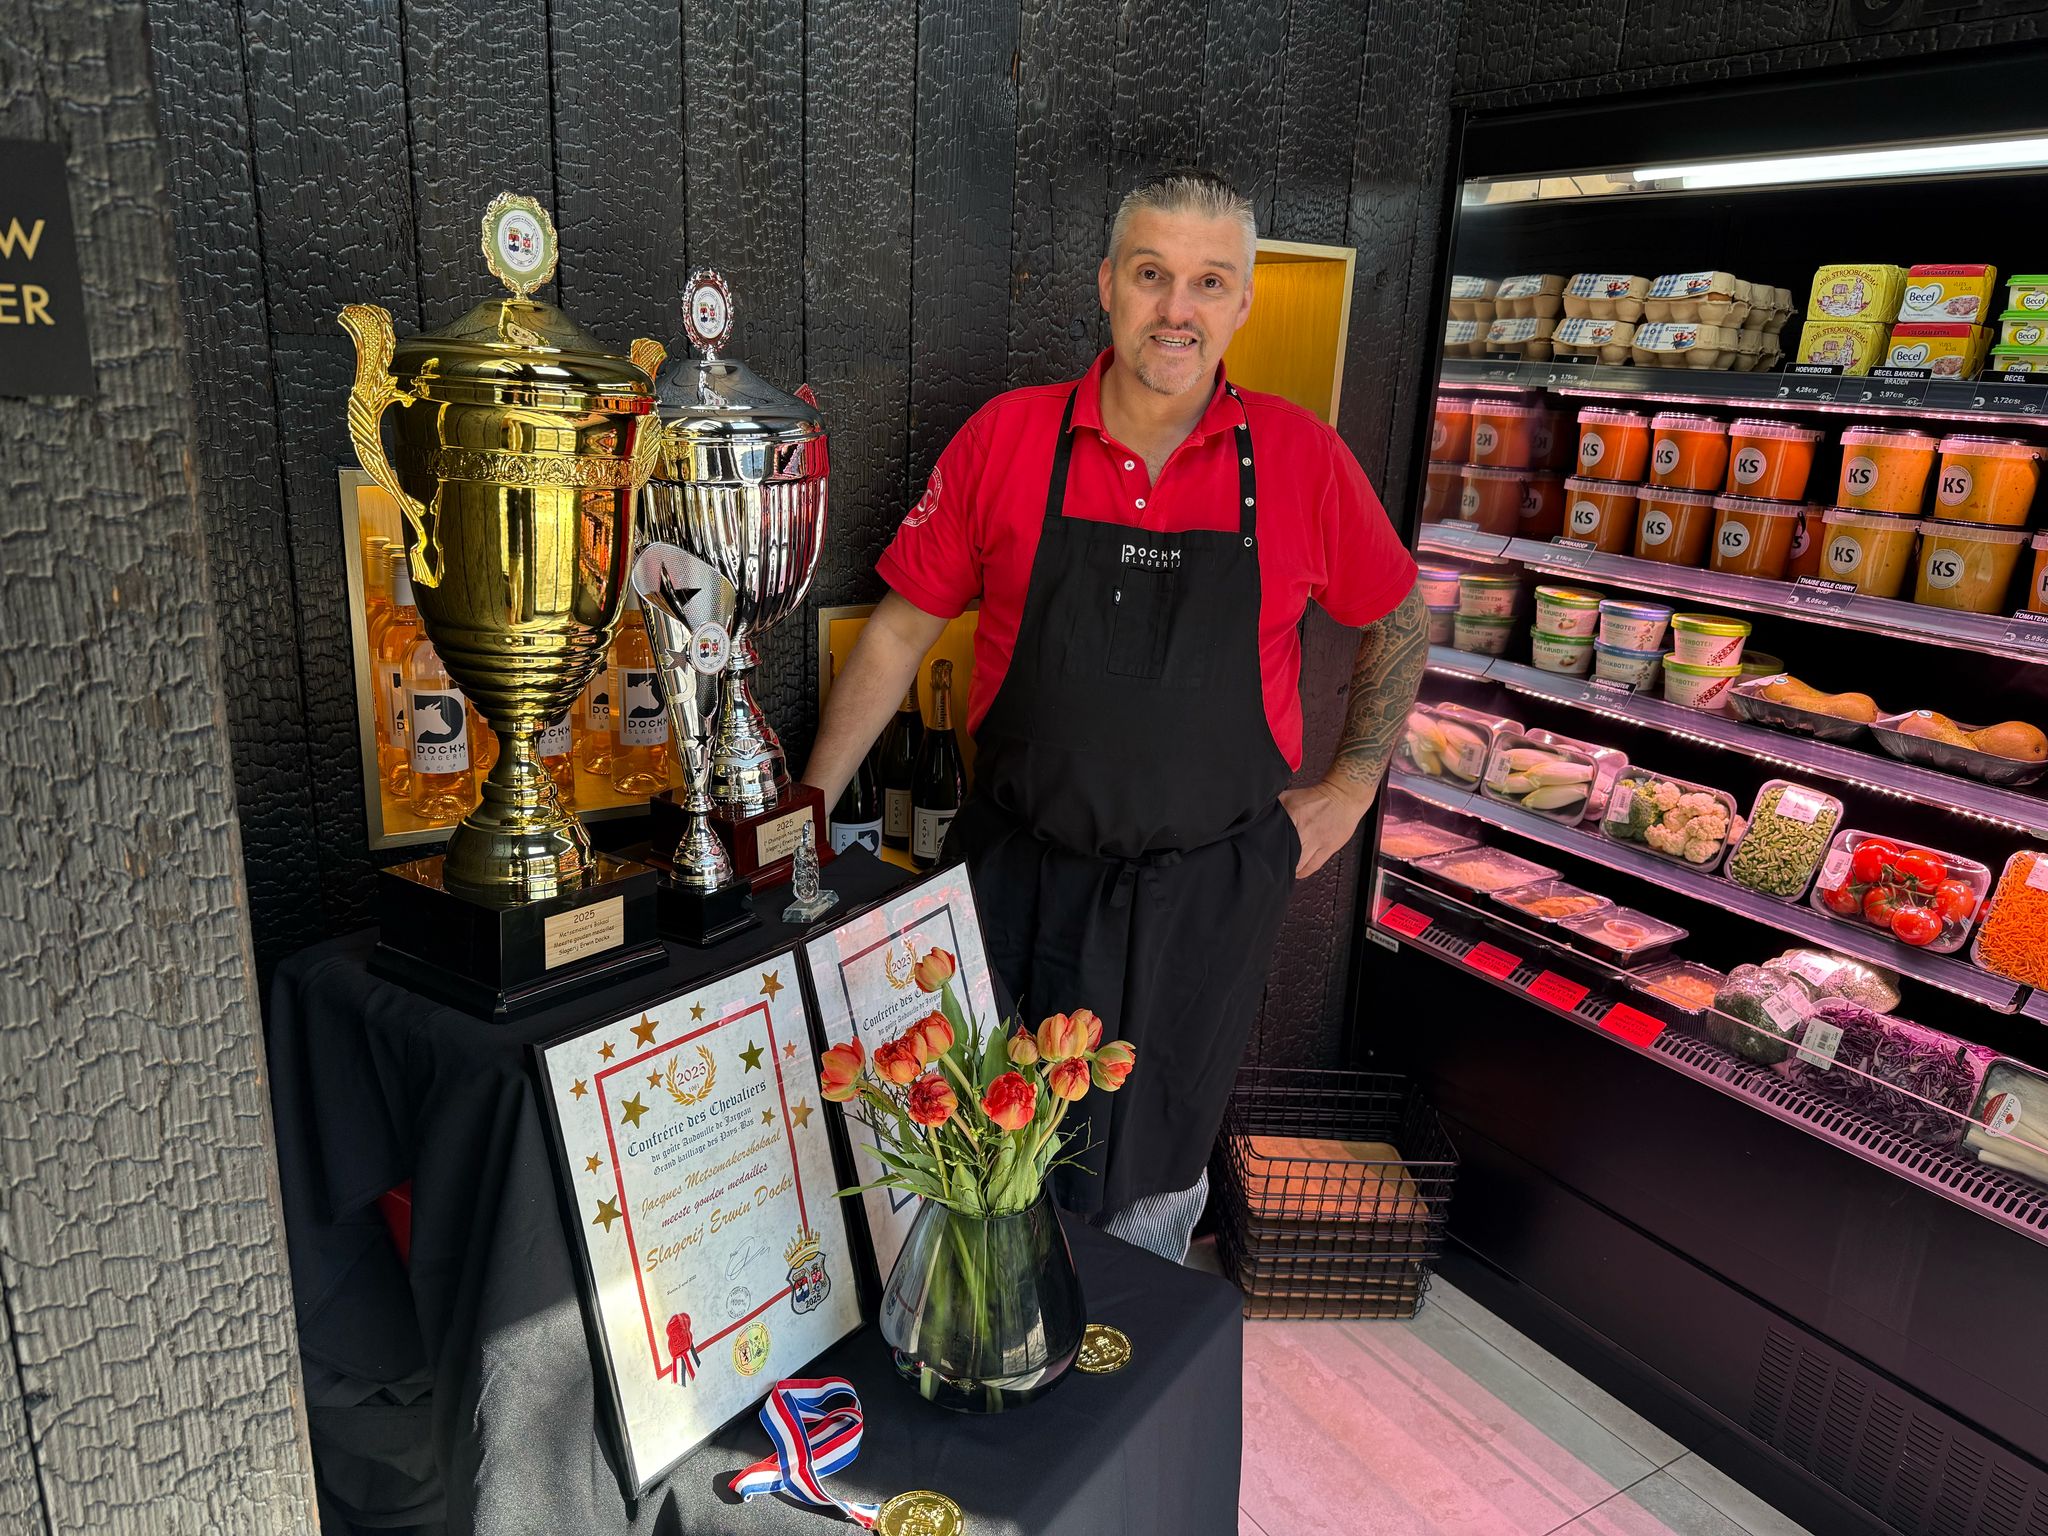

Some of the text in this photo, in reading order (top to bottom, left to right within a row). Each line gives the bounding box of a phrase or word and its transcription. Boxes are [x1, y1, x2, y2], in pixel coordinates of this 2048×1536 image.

[1909, 291, 1935, 302] Becel
[2025, 297, 2045, 305] Becel
[2018, 332, 2037, 340] Becel
[1896, 351, 1922, 361] Becel
[1795, 366, 1833, 374] HOEVEBOTER
[1873, 369, 1893, 377] BECEL
[1893, 370, 1919, 378] BAKKEN
[1884, 378, 1909, 386] BRADEN
[2003, 375, 2026, 383] BECEL
[1582, 442, 1599, 457] KS
[1655, 450, 1674, 464] KS
[1738, 458, 1760, 474] KS
[1848, 468, 1871, 484] KS
[1942, 477, 1967, 494] KS
[1573, 510, 1594, 525] KS
[1645, 520, 1666, 535] KS
[1721, 531, 1744, 547] KS
[1792, 536, 1802, 549] S
[1125, 556, 1181, 569] SLAGERIJ
[1834, 548, 1855, 563] KS
[1931, 560, 1957, 578] KS
[1800, 577, 1856, 592] THAISE GELE CURRY
[628, 716, 668, 728] DOCKX
[540, 725, 571, 738] OCKX
[417, 742, 467, 755] DOCKX
[417, 752, 466, 762] SLAGERIJ
[776, 818, 794, 832] 2025
[573, 909, 596, 924] 2025
[580, 940, 594, 949] Erwin
[594, 934, 610, 944] Dockx
[891, 954, 912, 974] 2025
[899, 991, 914, 1008] des
[676, 1062, 706, 1087] 2025
[627, 1079, 767, 1158] Confrérie des Chevaliers
[650, 1152, 661, 1163] du
[715, 1118, 723, 1130] de
[653, 1157, 677, 1176] Grand
[706, 1137, 719, 1148] des
[719, 1118, 755, 1142] Pays-Bas
[641, 1127, 782, 1221] Jacques Metsemakersbokaal
[661, 1162, 768, 1229] meeste gouden medailles
[645, 1173, 794, 1273] Slagerij Erwin Dockx
[805, 1293, 822, 1309] 2025
